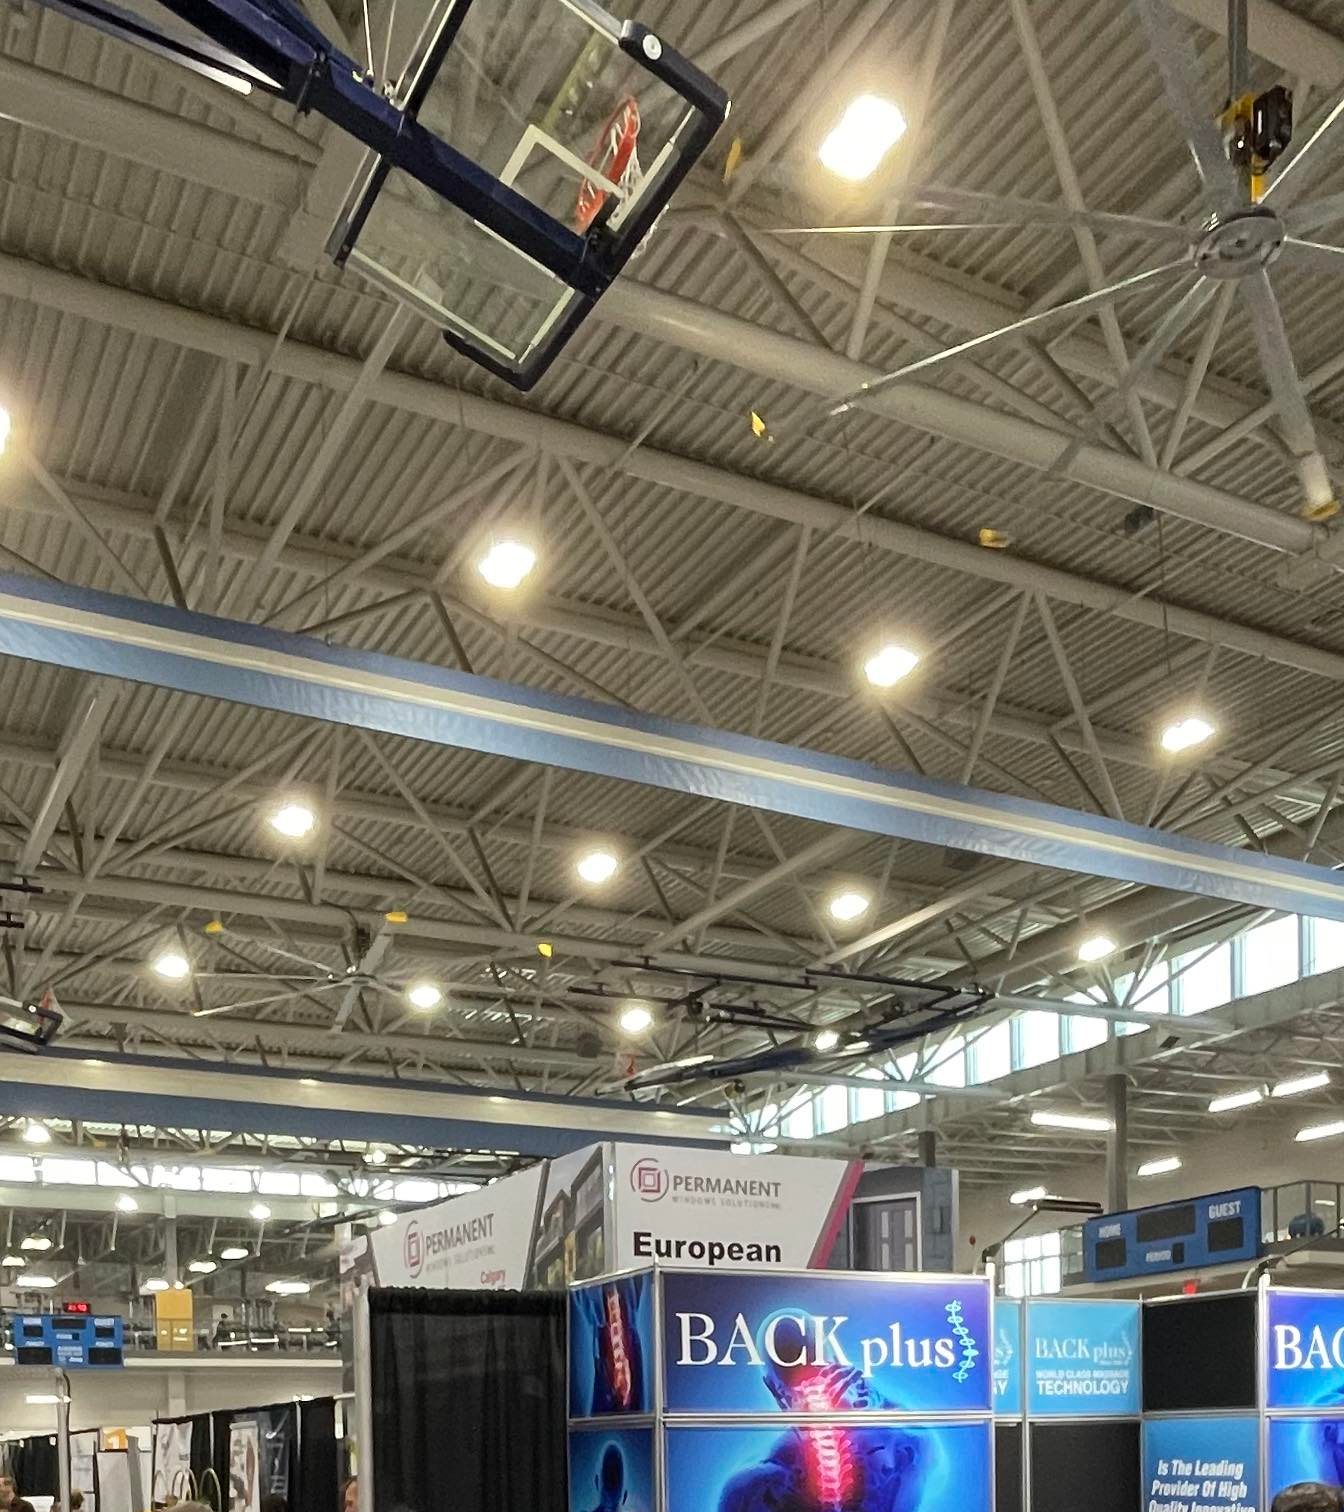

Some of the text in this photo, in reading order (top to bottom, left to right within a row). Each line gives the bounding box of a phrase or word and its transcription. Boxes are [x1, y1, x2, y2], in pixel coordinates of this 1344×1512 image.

[672, 1174, 782, 1198] PERMANENT
[1208, 1200, 1241, 1219] GUEST
[425, 1213, 494, 1257] PERMANENT
[632, 1231, 782, 1266] European
[675, 1312, 956, 1379] BACK plus
[1035, 1337, 1127, 1363] BACK plus
[1035, 1380, 1130, 1396] TECHNOLOGY
[1157, 1459, 1244, 1480] Is The Leading
[1151, 1480, 1248, 1501] Provider Of High
